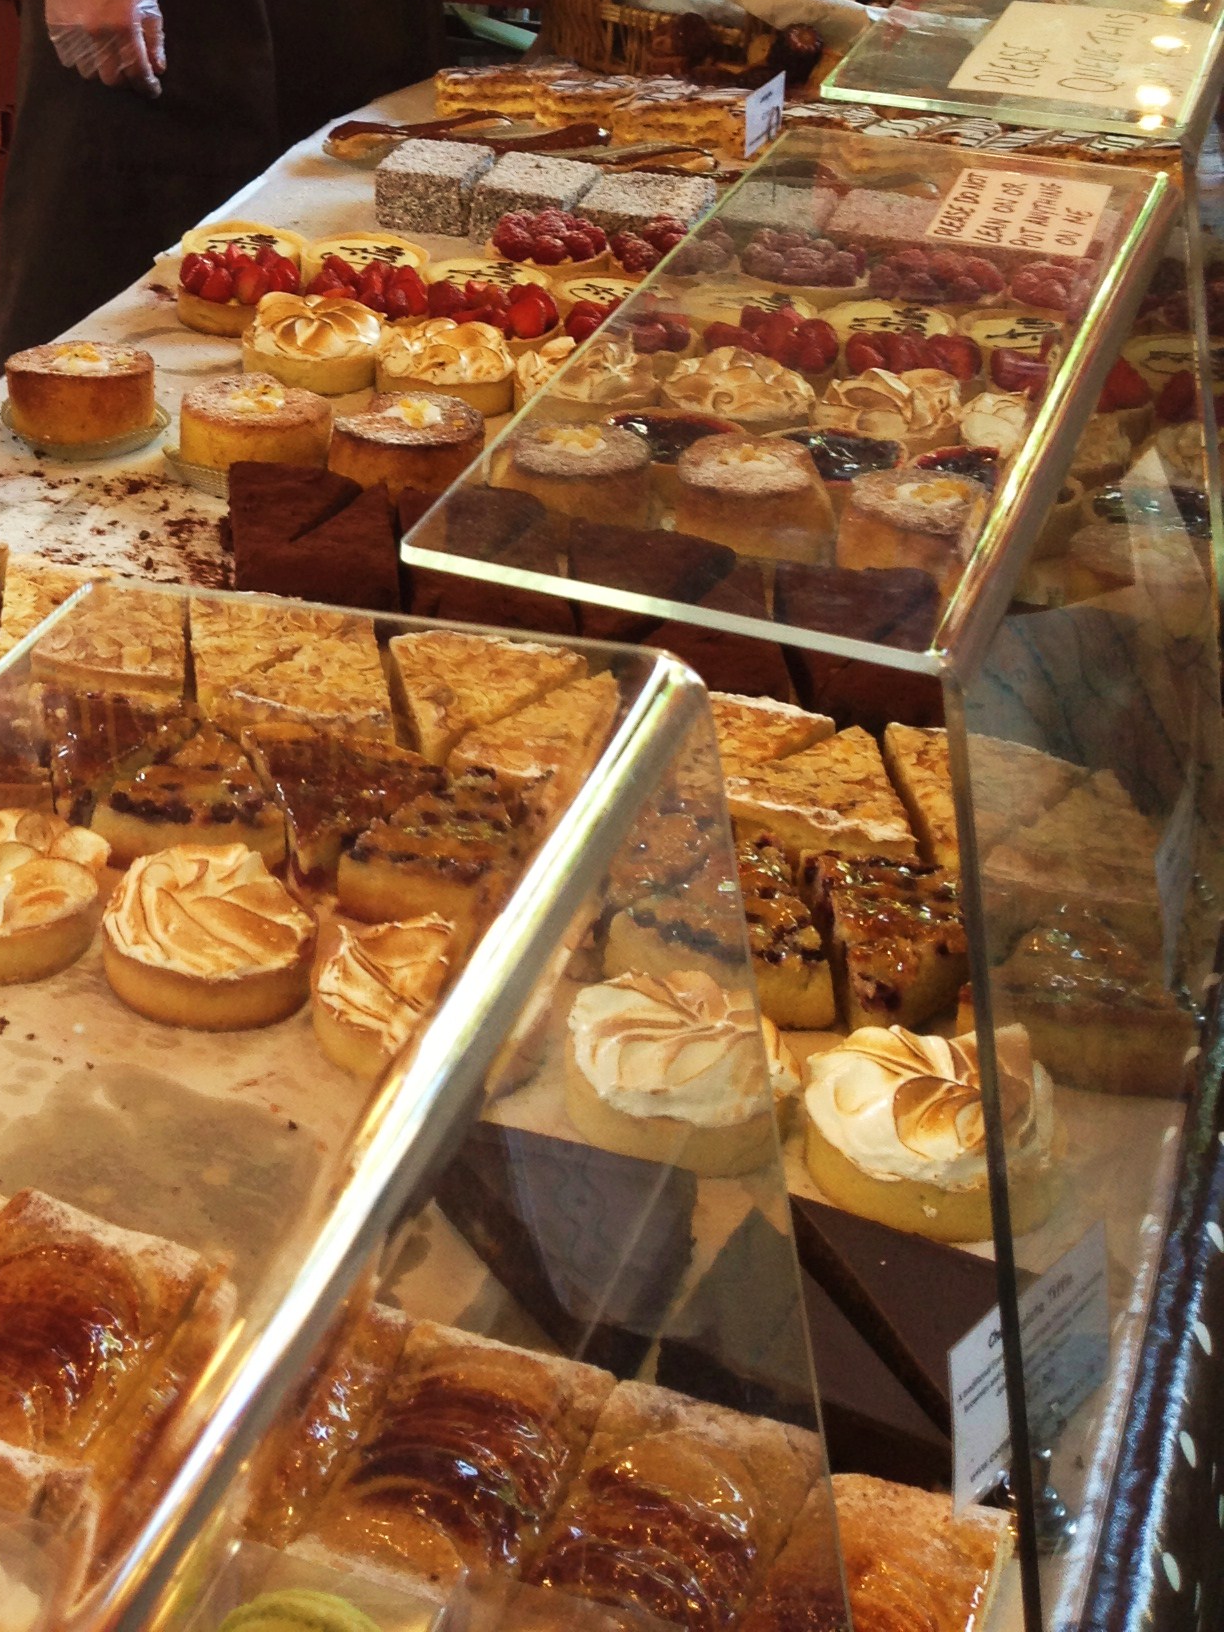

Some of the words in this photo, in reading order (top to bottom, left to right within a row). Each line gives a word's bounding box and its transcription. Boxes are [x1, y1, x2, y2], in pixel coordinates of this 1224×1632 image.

[1087, 13, 1148, 45] THIS
[973, 41, 1051, 88] PLEASE
[1057, 45, 1125, 93] QUEUE
[961, 172, 989, 191] NOT
[1001, 182, 1029, 196] OR
[954, 190, 980, 205] DO
[992, 197, 1019, 214] ON
[1023, 182, 1063, 227] ANYTHING
[933, 204, 975, 238] PLEASE
[1063, 207, 1094, 226] ME
[972, 217, 1012, 244] LEAN
[1009, 226, 1046, 249] PUT
[1055, 229, 1083, 246] ON
